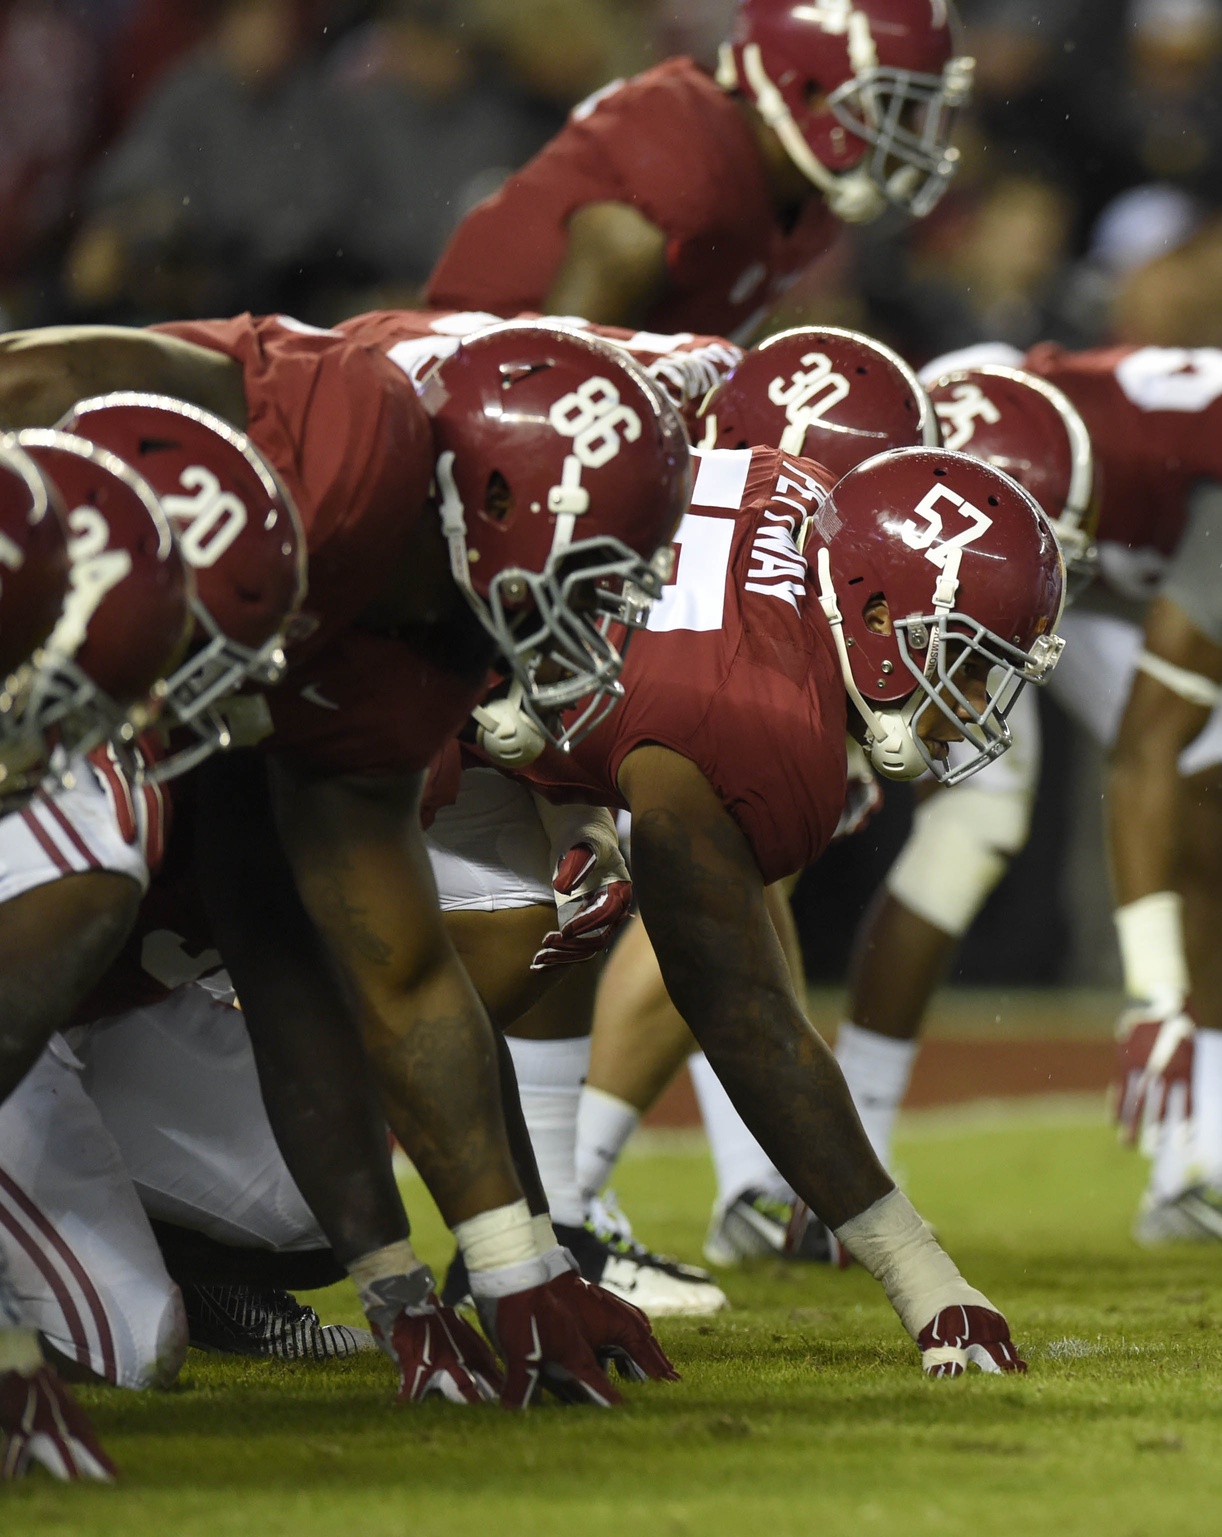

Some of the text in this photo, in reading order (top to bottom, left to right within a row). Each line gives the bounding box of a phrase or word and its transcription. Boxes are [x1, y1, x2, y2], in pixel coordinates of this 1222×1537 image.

[549, 375, 641, 468] 86
[768, 352, 850, 425] 30
[162, 465, 247, 568] 20
[900, 482, 993, 568] 57
